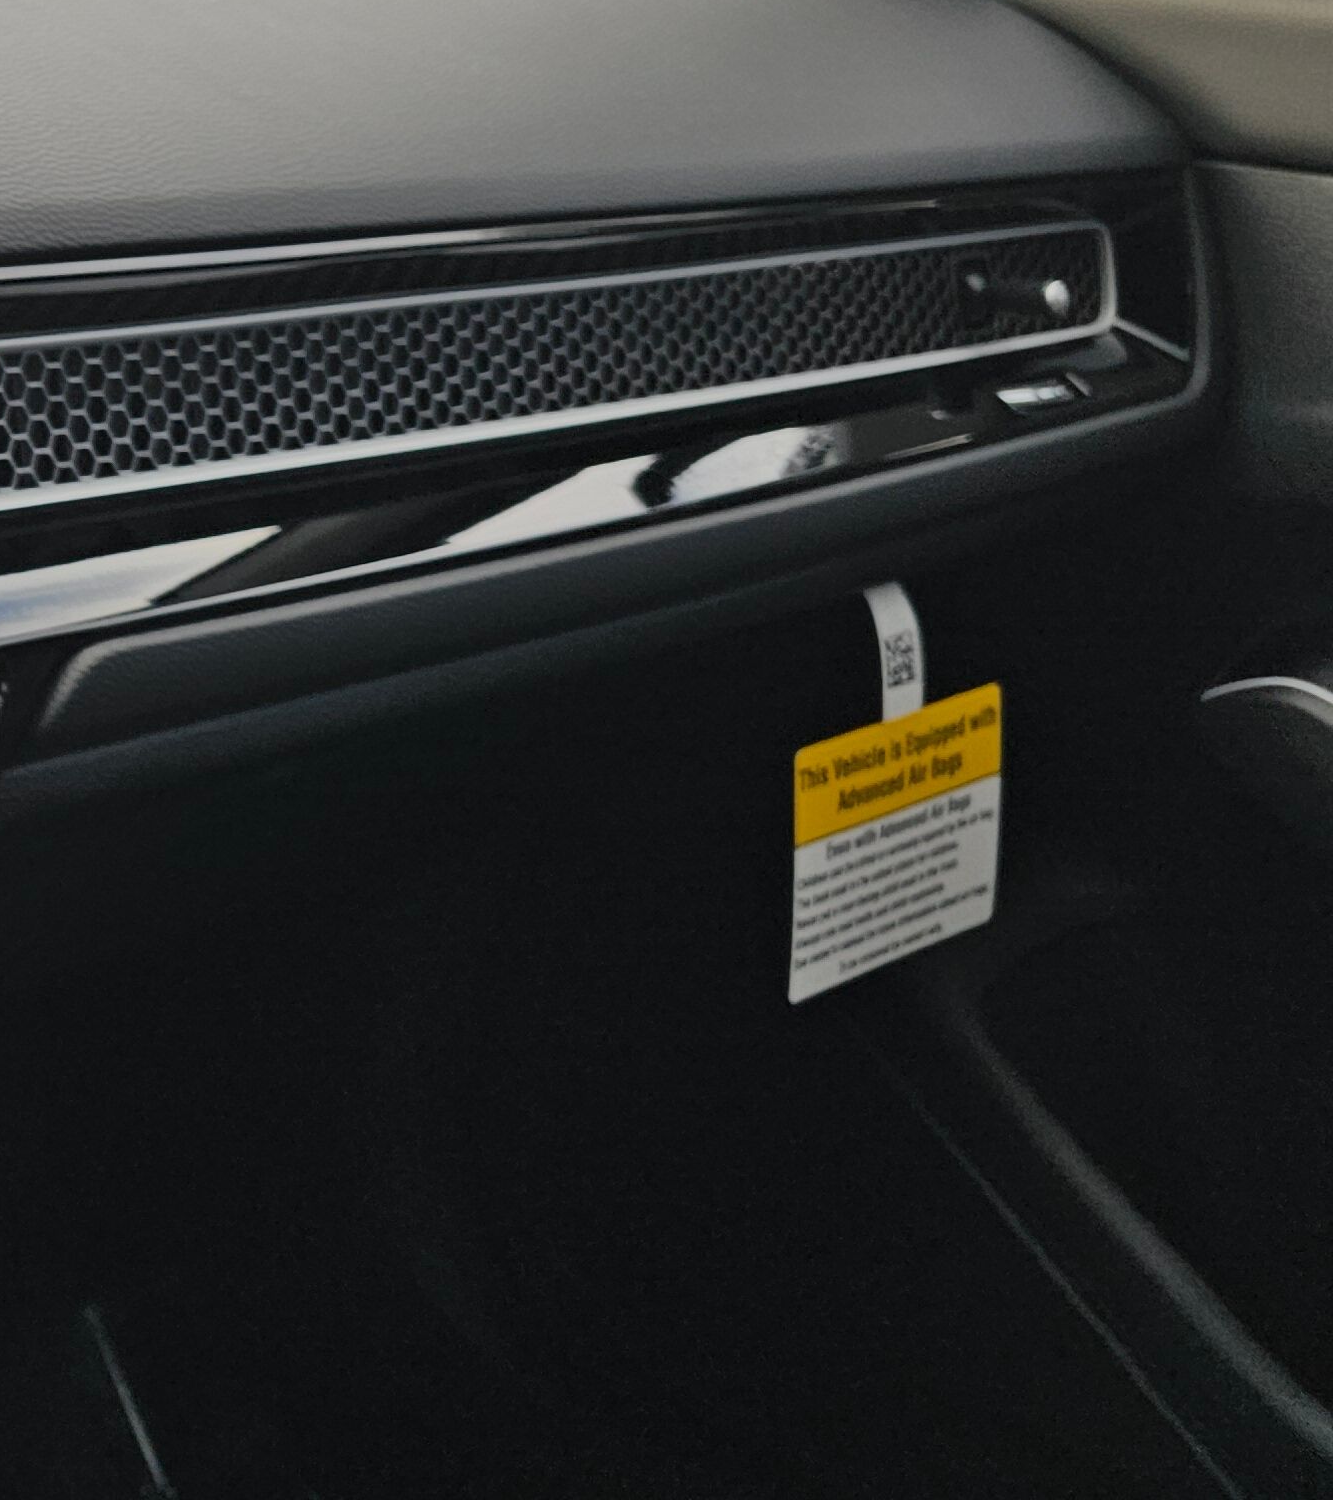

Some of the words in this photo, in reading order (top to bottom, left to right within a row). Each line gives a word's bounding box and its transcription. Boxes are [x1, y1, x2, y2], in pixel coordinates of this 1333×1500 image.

[800, 765, 829, 792] This
[833, 744, 885, 780] Vehicle
[890, 738, 902, 761] is
[906, 715, 965, 756] Equipped
[970, 705, 996, 731] with
